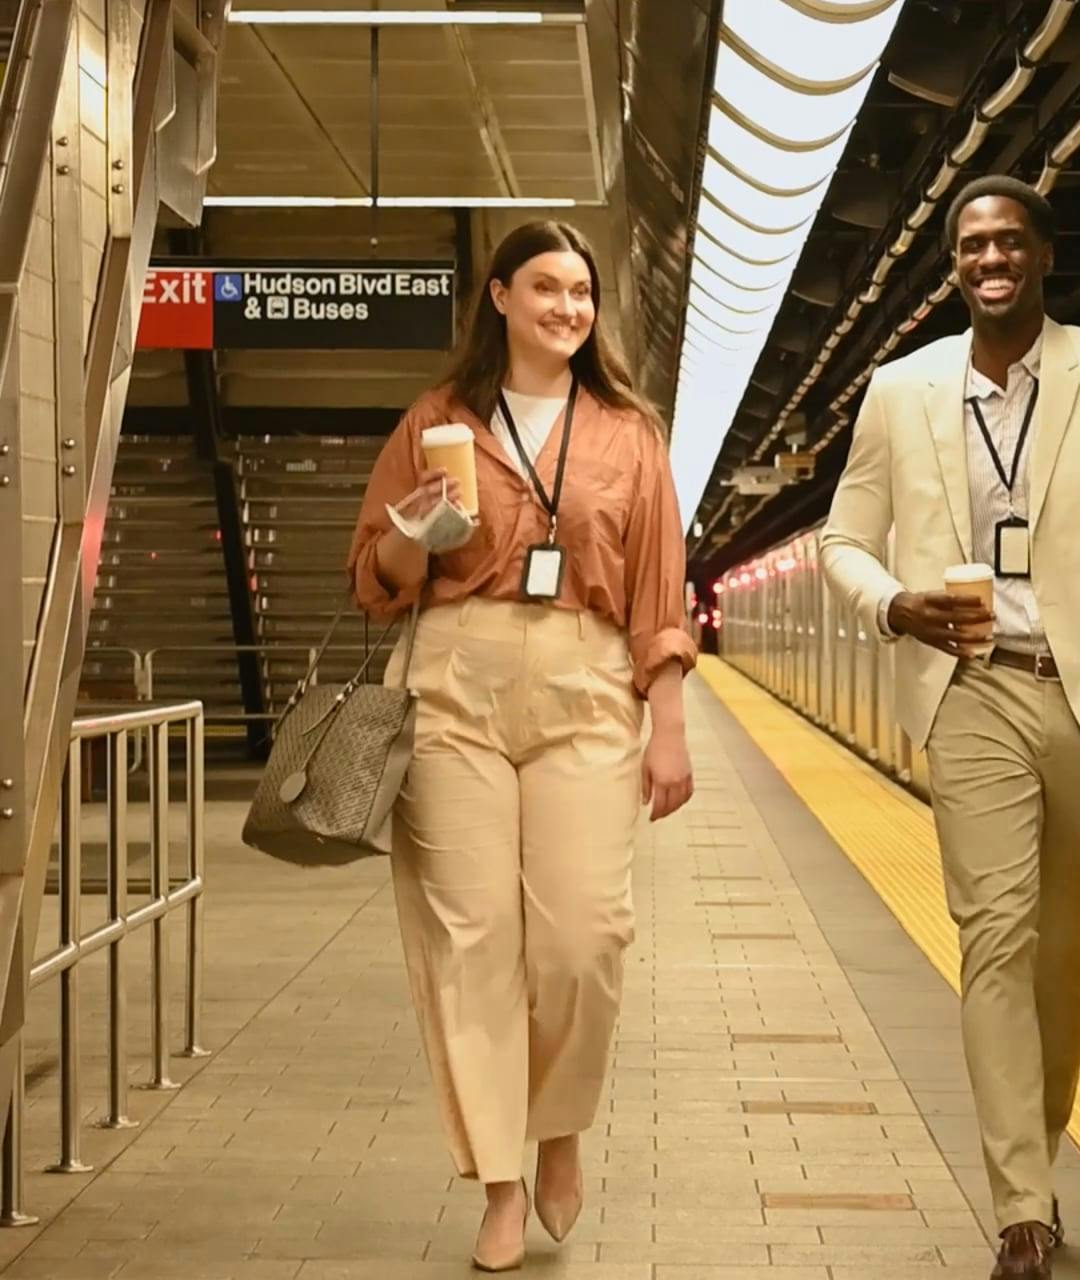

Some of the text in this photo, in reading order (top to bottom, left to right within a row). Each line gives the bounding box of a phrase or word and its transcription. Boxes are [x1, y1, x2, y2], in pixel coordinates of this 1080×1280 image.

[143, 272, 207, 304] Exit
[244, 272, 450, 296] Hudson Blvd East
[244, 297, 369, 320] & Buses
